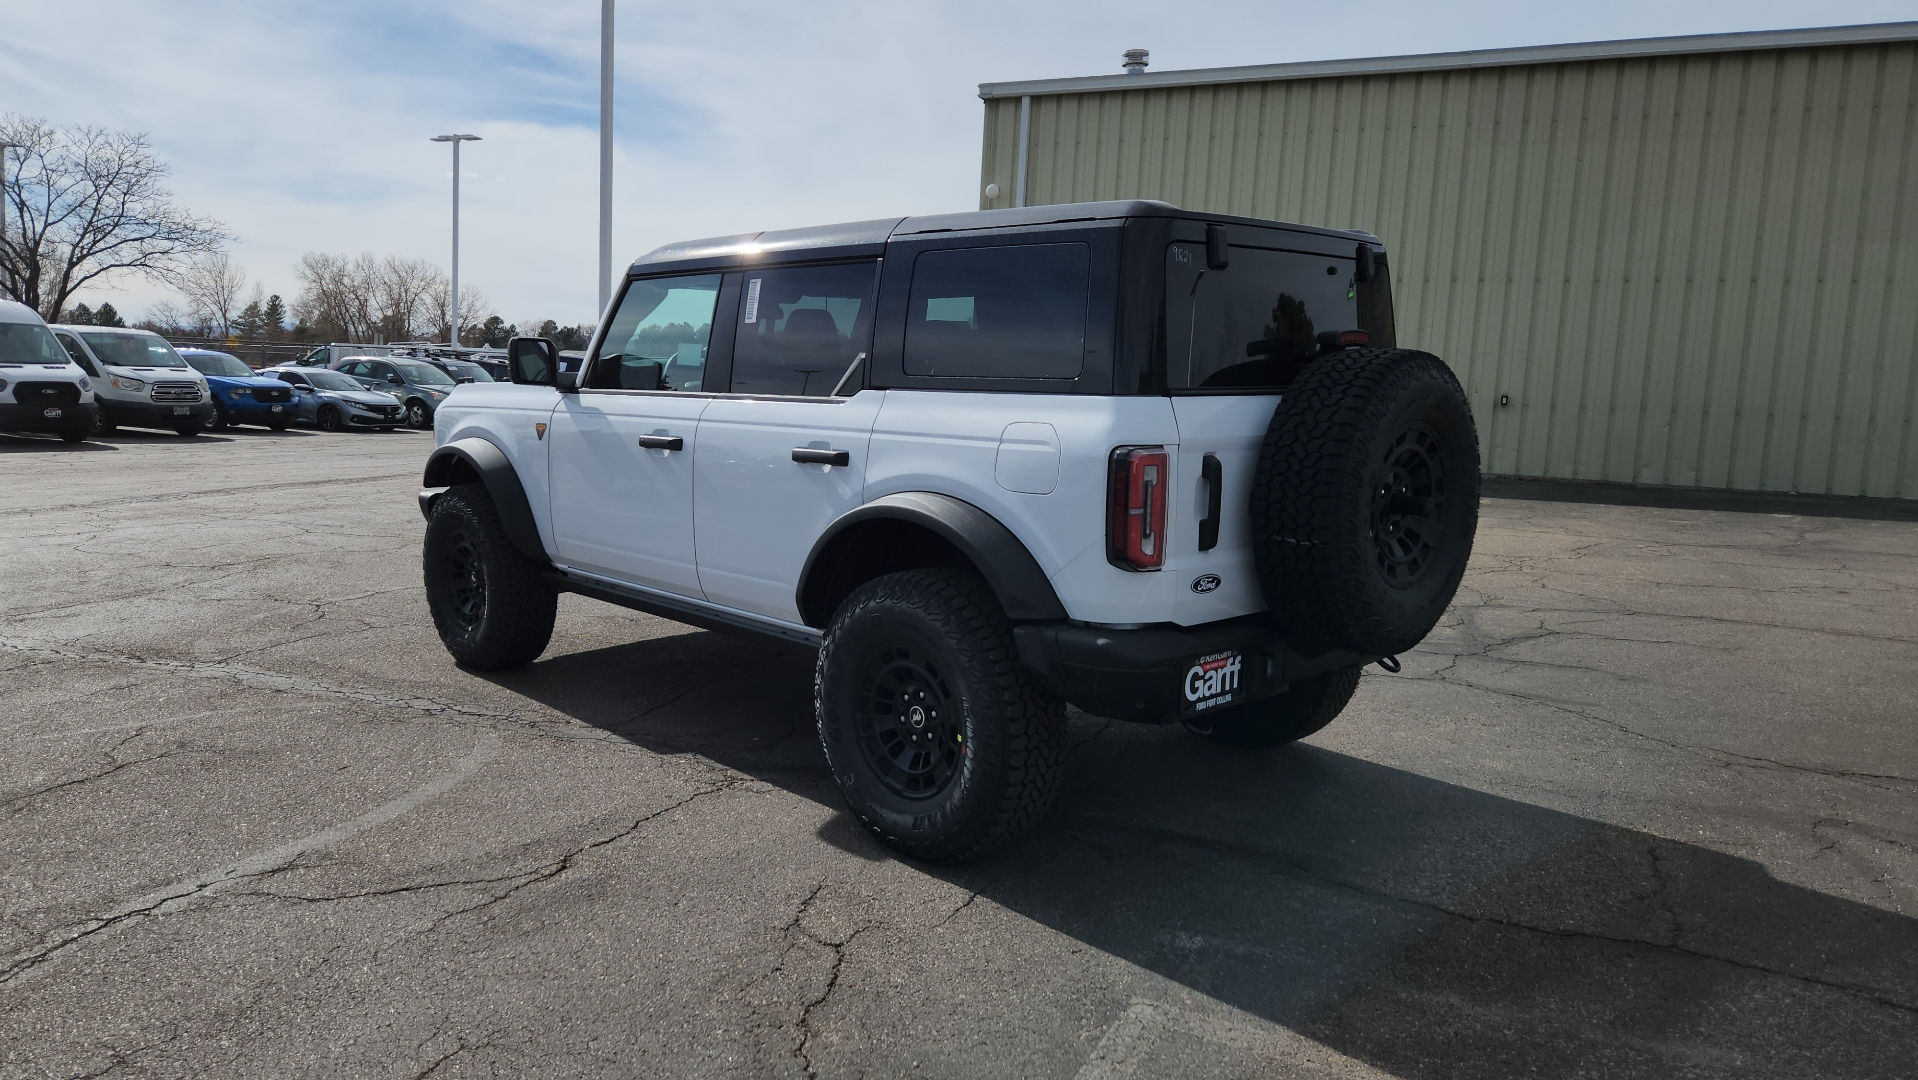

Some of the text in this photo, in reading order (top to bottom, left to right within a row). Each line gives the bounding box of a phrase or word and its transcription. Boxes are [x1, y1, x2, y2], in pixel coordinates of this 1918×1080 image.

[1197, 577, 1218, 591] Ford
[1184, 655, 1242, 702] Garff
[1206, 697, 1217, 708] FORT
